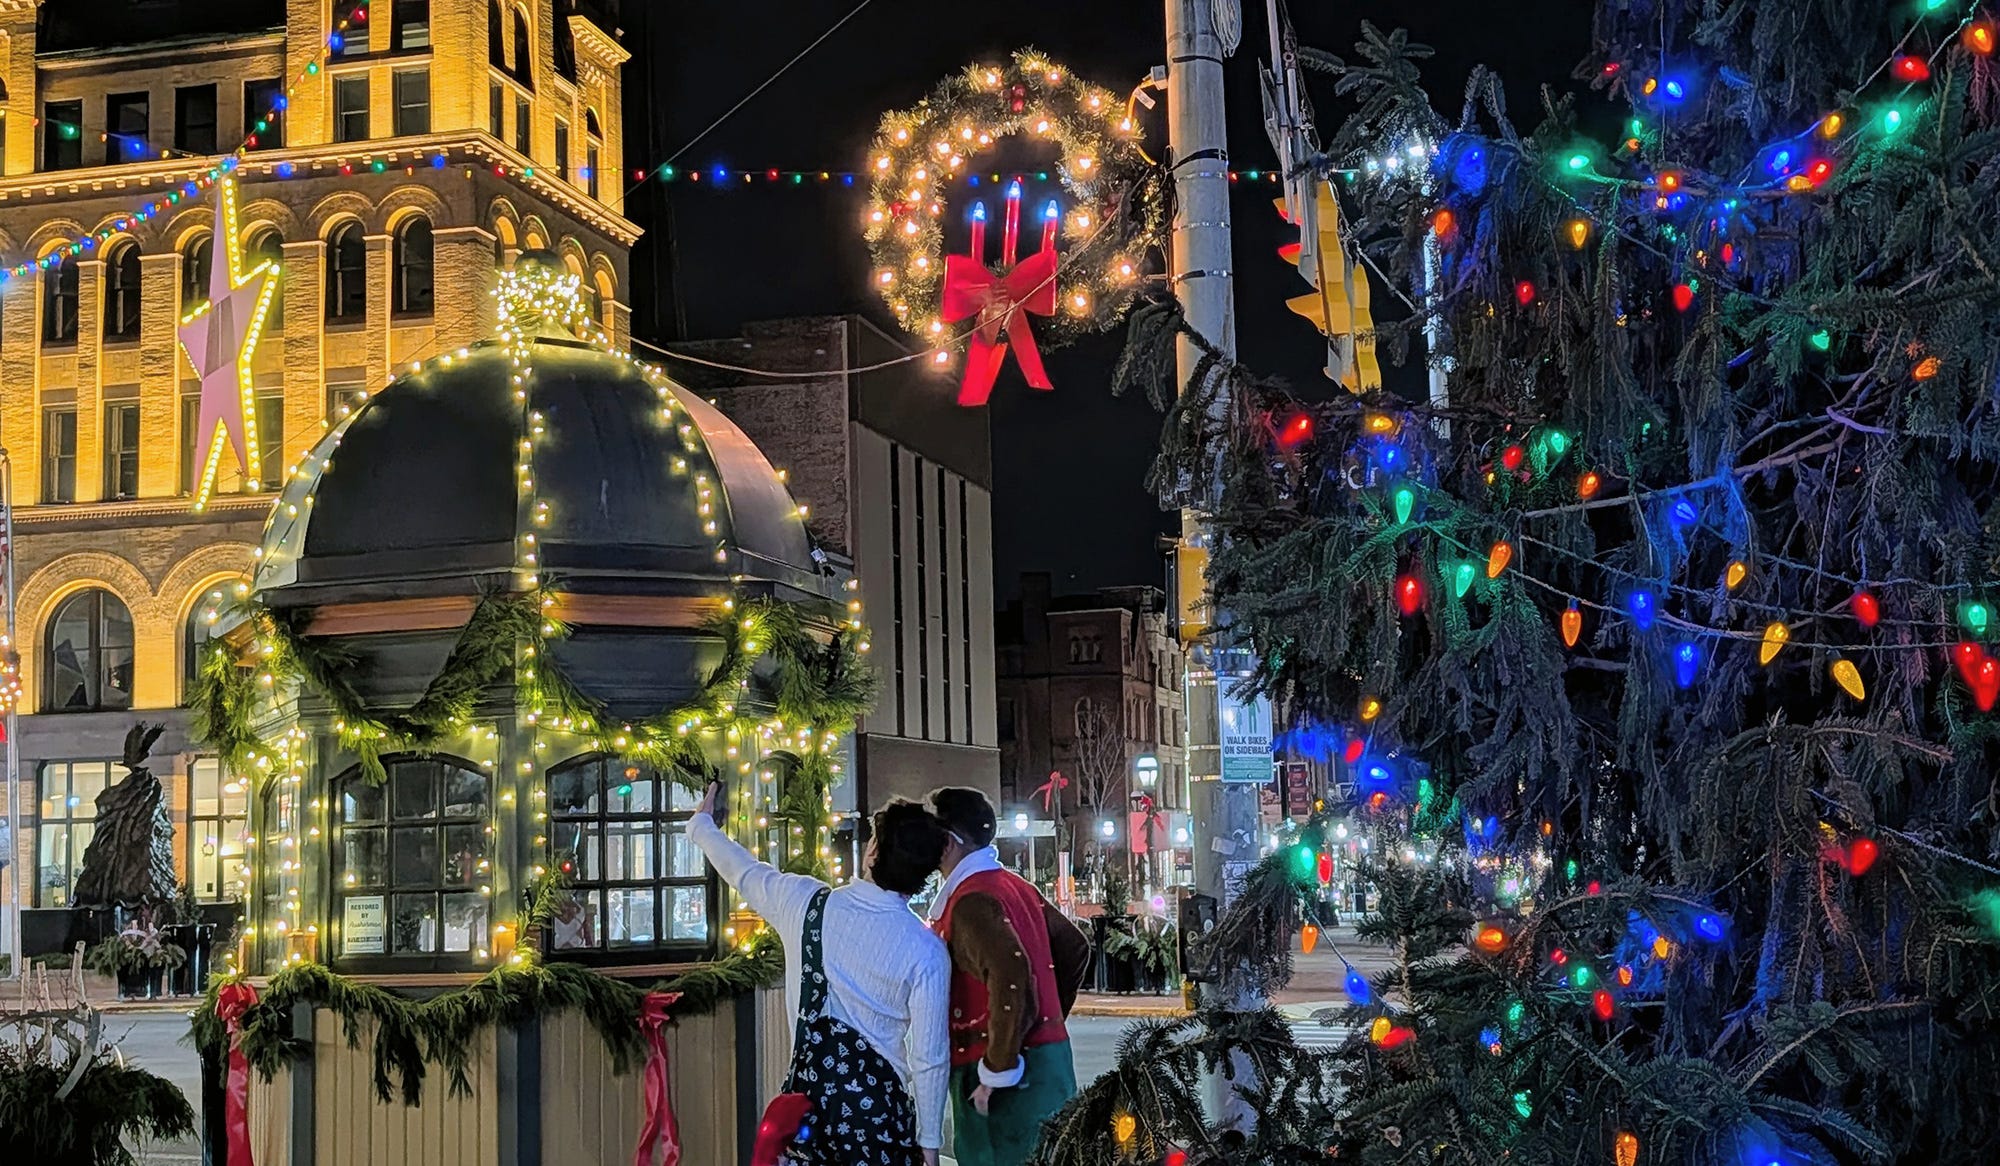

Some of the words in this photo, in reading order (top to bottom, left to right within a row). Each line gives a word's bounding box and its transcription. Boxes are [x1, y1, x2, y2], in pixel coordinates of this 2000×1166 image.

[1226, 736, 1247, 745] WALK
[1248, 736, 1267, 745] BIKES
[1224, 745, 1235, 754] ON
[1236, 745, 1270, 754] SIDEWALK
